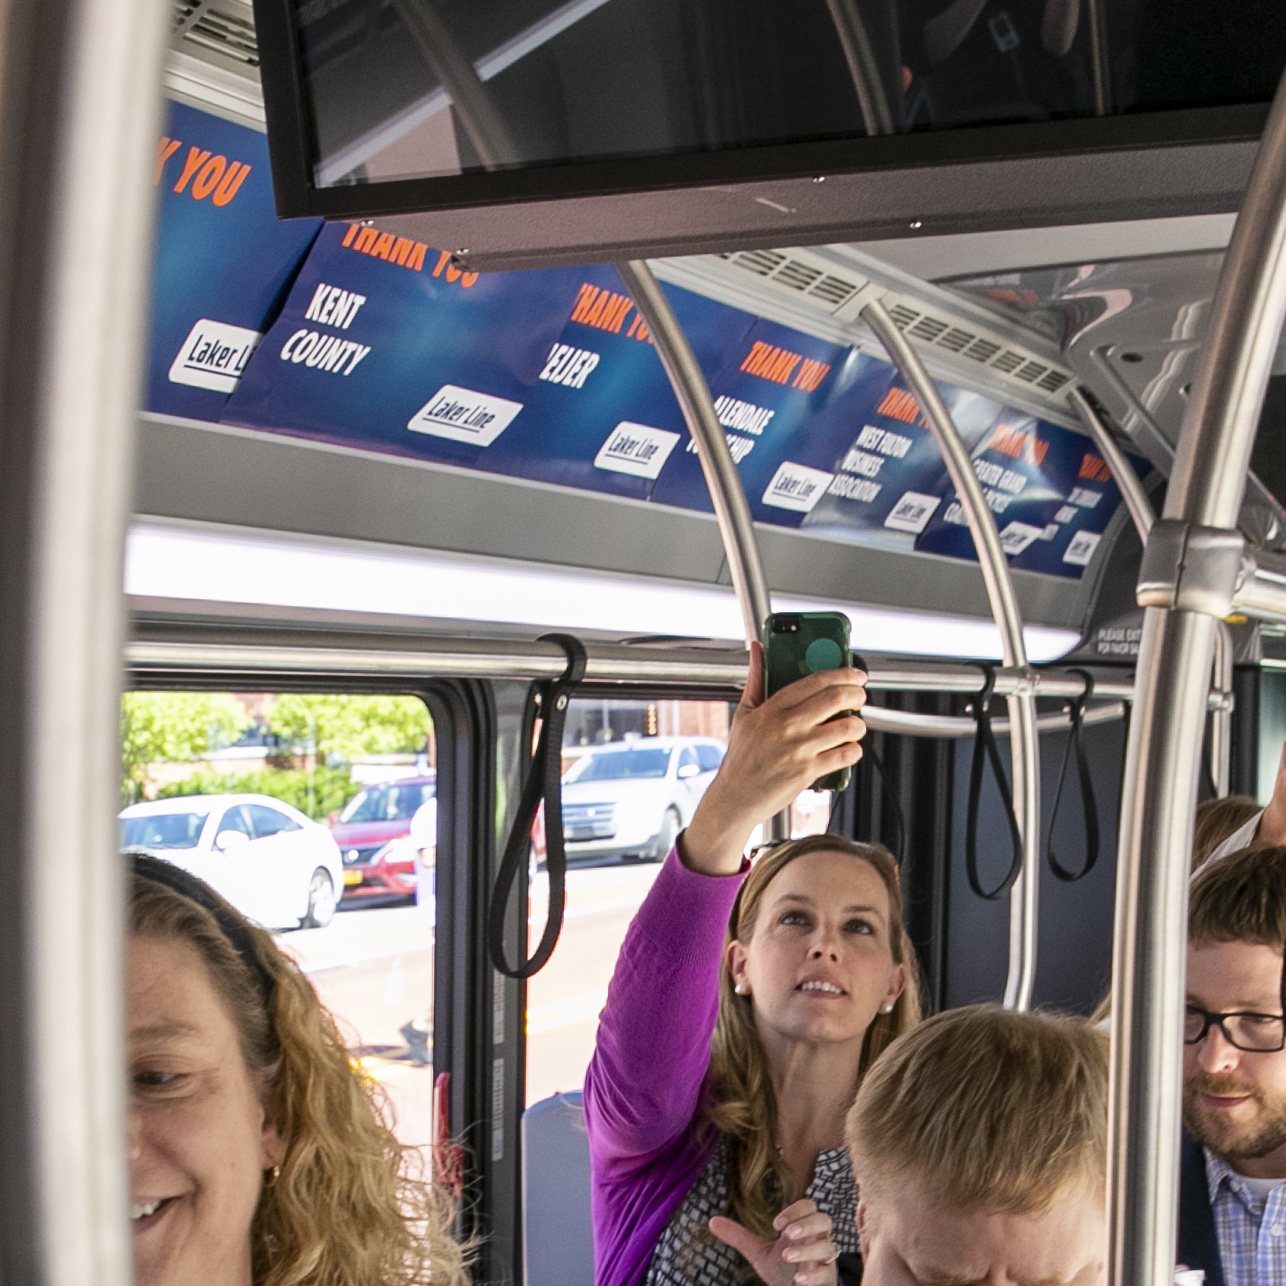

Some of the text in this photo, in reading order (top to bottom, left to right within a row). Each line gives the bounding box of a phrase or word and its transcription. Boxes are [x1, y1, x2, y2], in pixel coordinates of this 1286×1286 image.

[173, 146, 252, 208] YOU
[304, 283, 367, 329] KENT
[571, 283, 634, 334] HANK
[187, 333, 239, 371] Laker
[280, 329, 372, 376] COUNTY
[739, 340, 831, 394] THANK YOU
[427, 397, 496, 430] Laker Line
